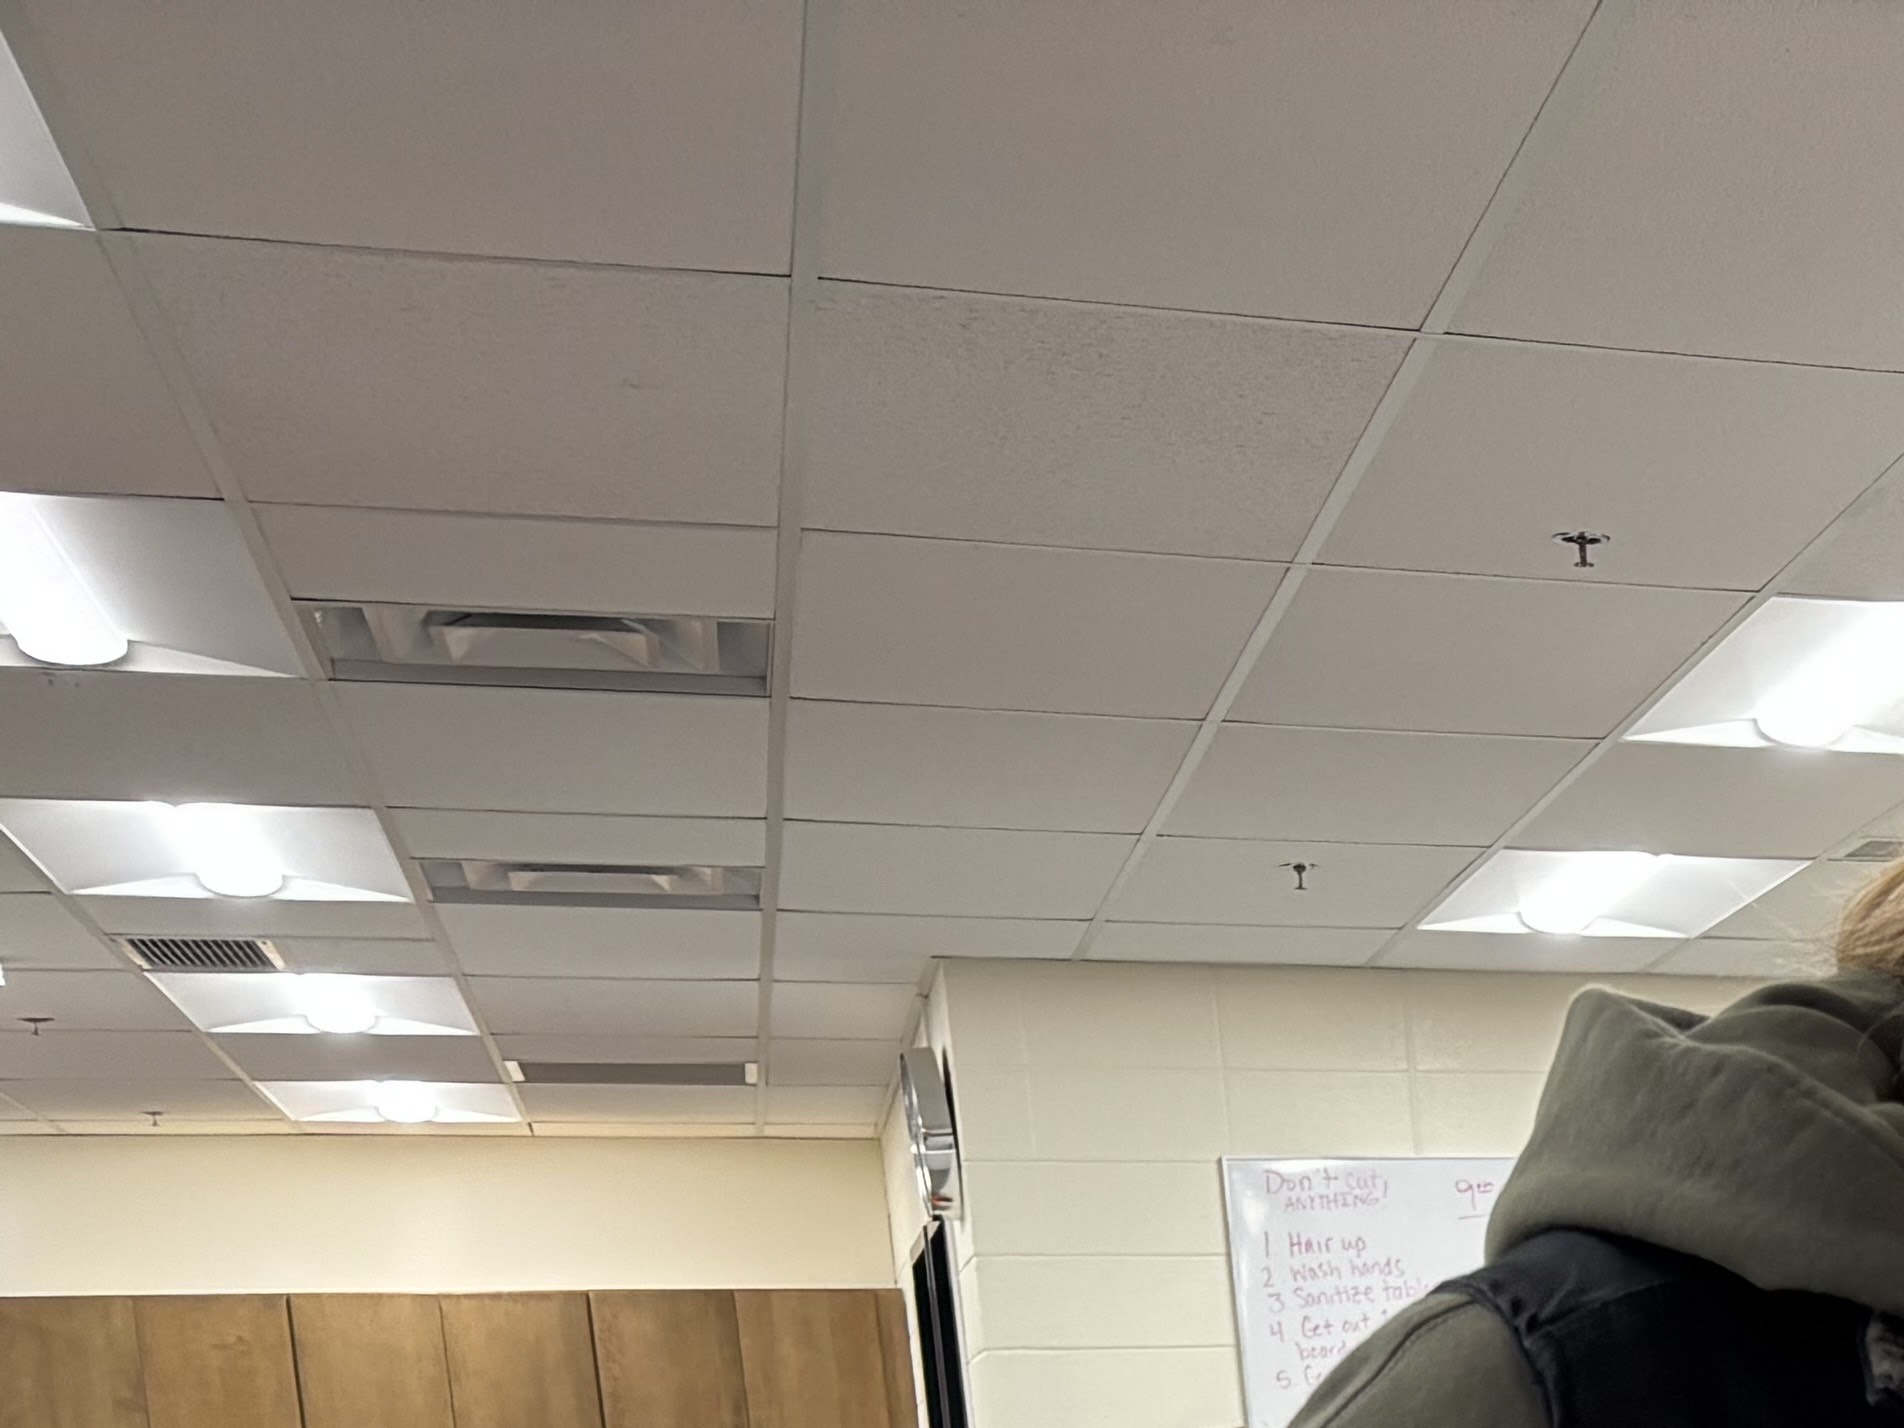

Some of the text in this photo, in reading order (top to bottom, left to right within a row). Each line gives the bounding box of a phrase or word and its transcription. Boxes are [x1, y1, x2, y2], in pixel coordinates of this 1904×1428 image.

[1263, 1167, 1339, 1195] Don't
[1287, 1231, 1333, 1258] Hair
[1340, 1235, 1367, 1258] up
[1289, 1260, 1343, 1282] Wash
[1348, 1256, 1406, 1278] hands
[1293, 1282, 1375, 1308] Sanitize
[1301, 1314, 1334, 1339] Get
[1342, 1313, 1370, 1333] out
